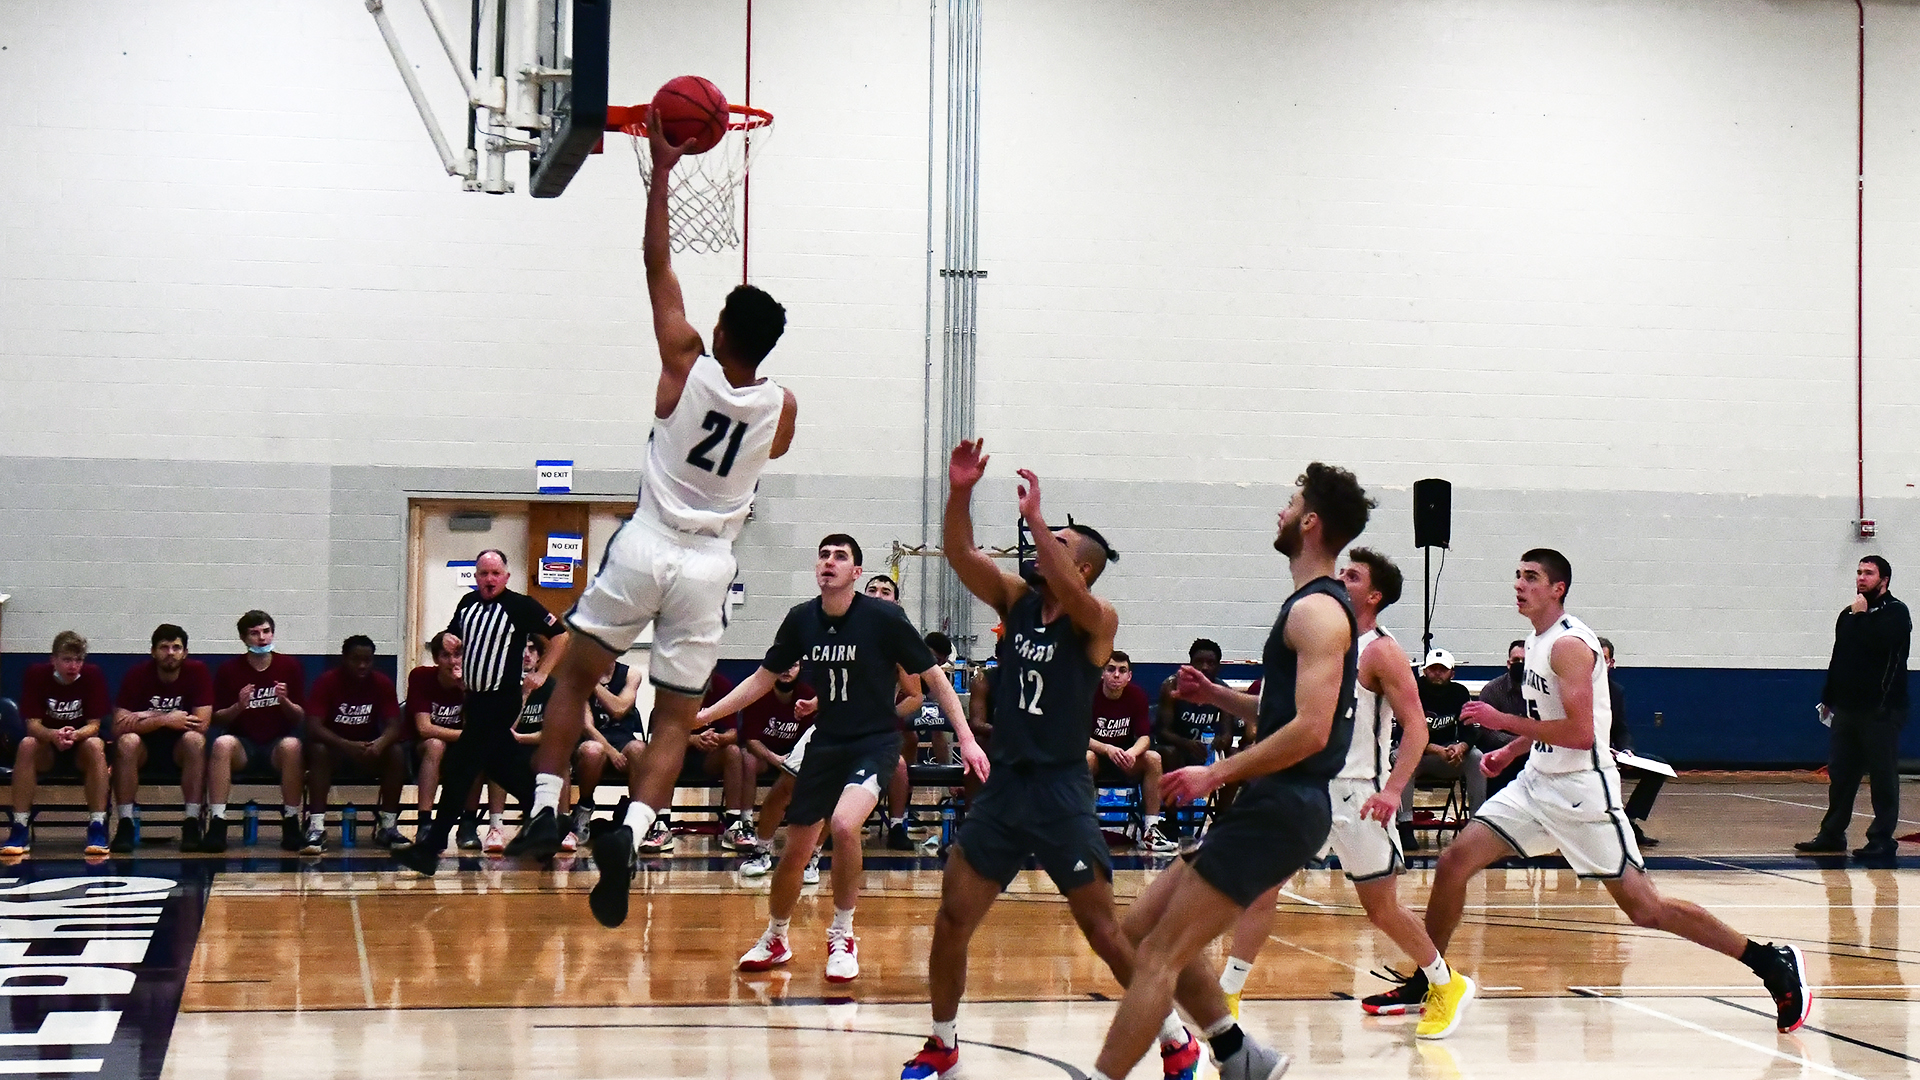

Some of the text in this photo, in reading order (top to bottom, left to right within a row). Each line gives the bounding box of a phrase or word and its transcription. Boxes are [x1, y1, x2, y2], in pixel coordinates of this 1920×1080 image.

[686, 410, 749, 477] 21
[812, 644, 857, 662] CAIRN
[828, 667, 848, 702] 11
[1018, 667, 1044, 715] 12
[1107, 717, 1131, 729] CAIRN
[1181, 711, 1214, 724] CAIRN
[1094, 727, 1131, 738] BASKETBALL
